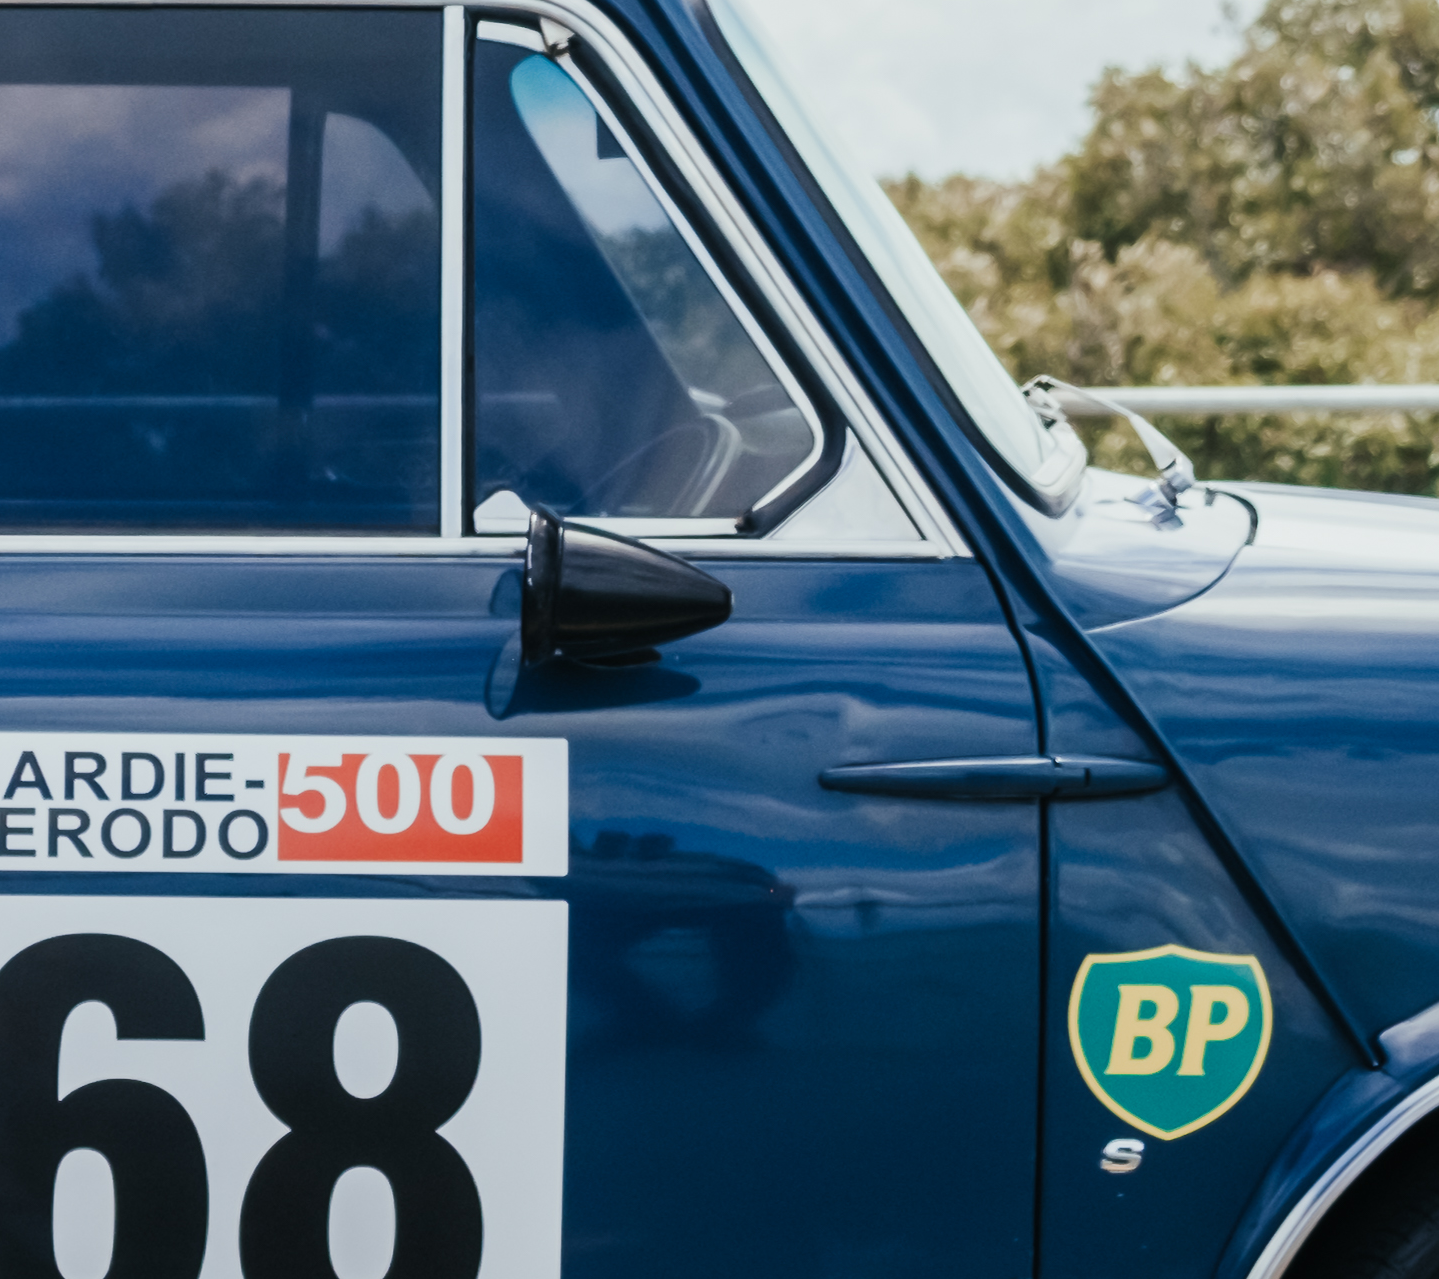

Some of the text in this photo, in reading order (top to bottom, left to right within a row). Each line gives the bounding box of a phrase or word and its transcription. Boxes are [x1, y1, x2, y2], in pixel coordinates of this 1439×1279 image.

[279, 751, 495, 835] 500
[1104, 984, 1249, 1076] BP
[1100, 1137, 1145, 1174] S
